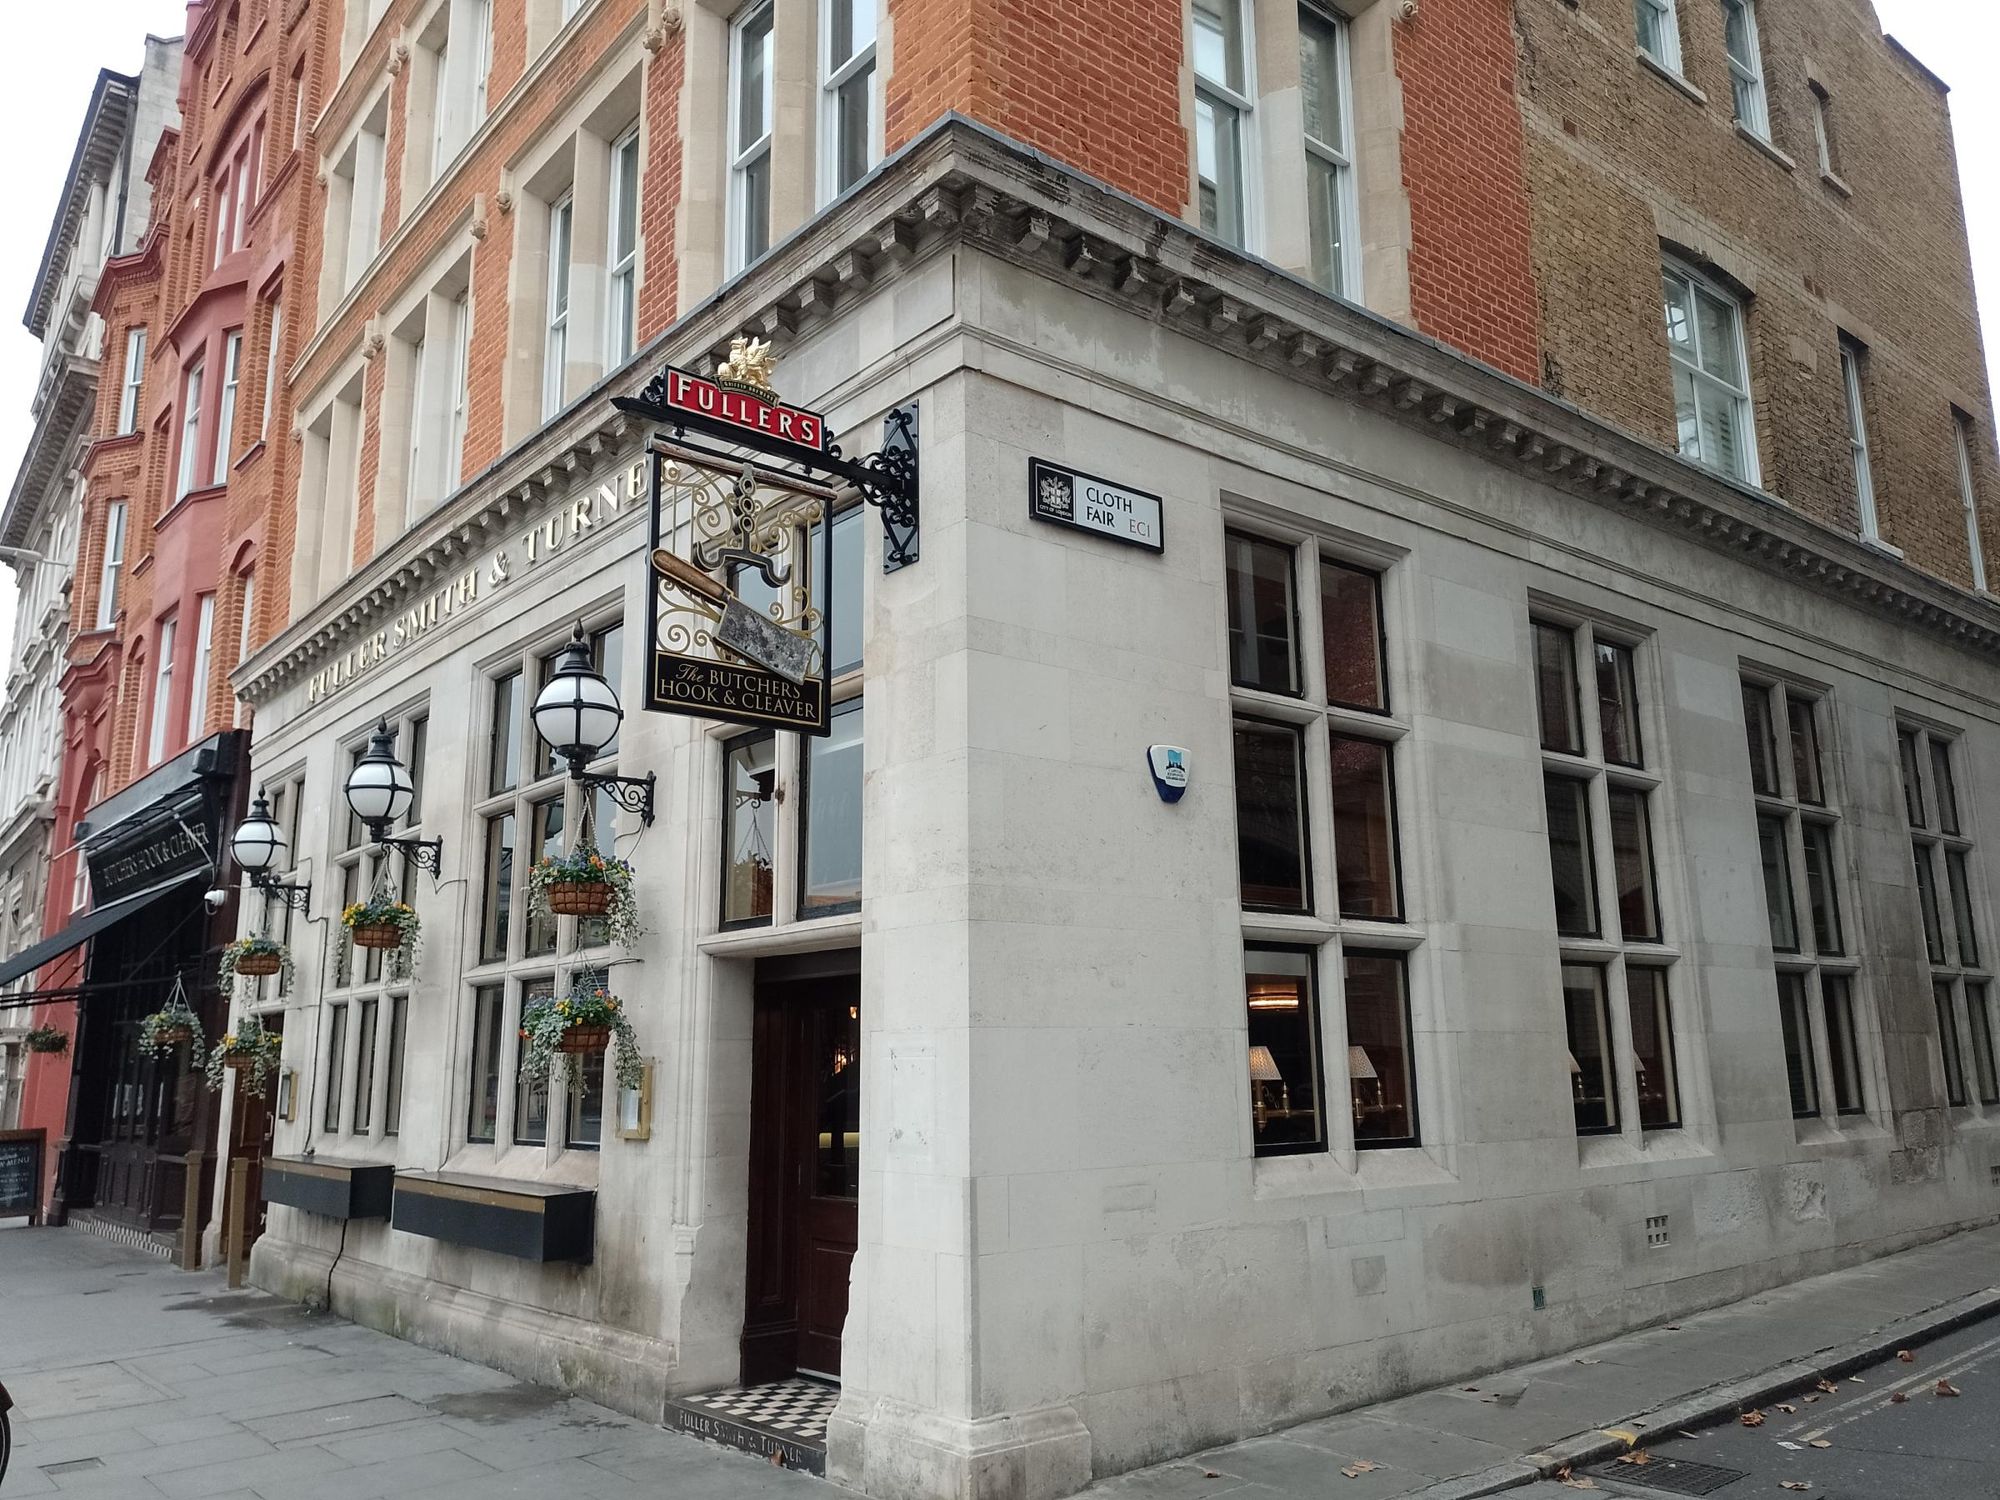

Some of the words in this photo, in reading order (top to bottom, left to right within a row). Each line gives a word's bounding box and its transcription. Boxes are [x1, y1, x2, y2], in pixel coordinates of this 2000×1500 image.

[677, 373, 814, 441] FULLER'S
[1086, 487, 1132, 513] CLOTH
[1086, 506, 1115, 528] FAIR
[1129, 519, 1150, 538] EC1
[308, 631, 387, 703] FULLER
[393, 567, 479, 648] SMITH
[488, 551, 511, 587] &
[661, 679, 719, 703] HOOK
[723, 690, 736, 706] &
[742, 693, 816, 719] CLEAVER
[676, 663, 704, 682] The
[710, 670, 801, 699] BUTCHERS
[680, 1409, 710, 1433] FULLER
